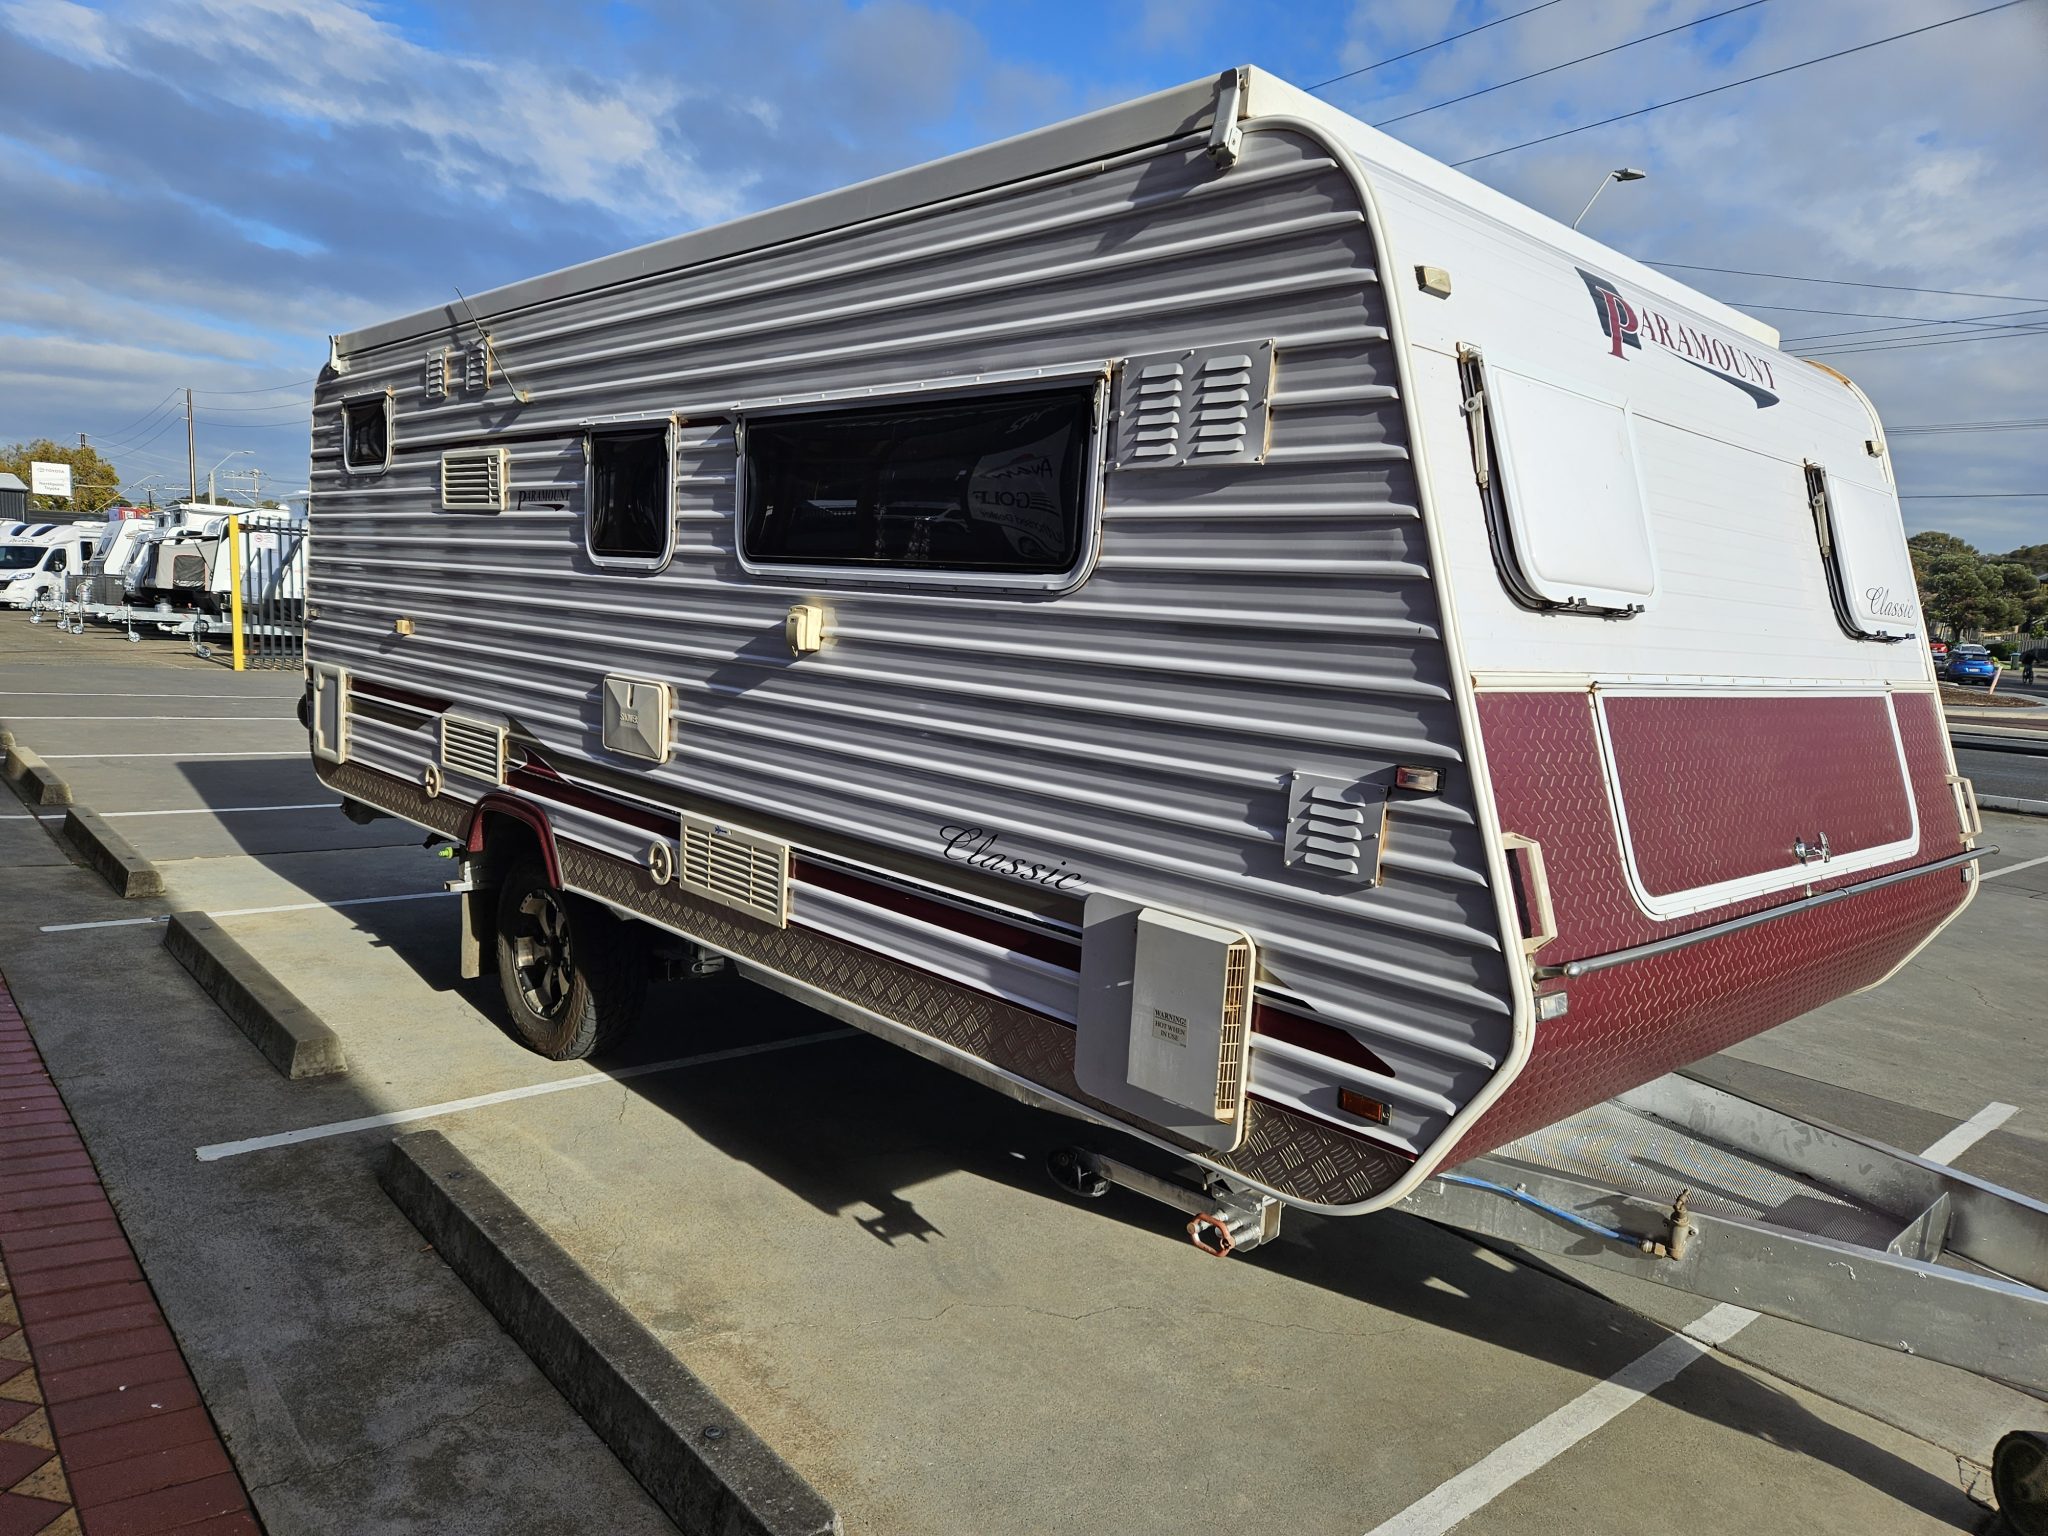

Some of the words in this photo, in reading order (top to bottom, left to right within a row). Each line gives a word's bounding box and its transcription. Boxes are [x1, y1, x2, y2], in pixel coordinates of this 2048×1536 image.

[1595, 285, 1776, 390] PARAMOUNT
[517, 488, 571, 511] PARAMOUNT
[1866, 586, 1915, 618] Classic
[939, 825, 1089, 890] Classic
[1154, 1009, 1187, 1025] WARNING!
[1155, 1020, 1167, 1029] HOT
[1167, 1024, 1185, 1036] WHEN
[1167, 1032, 1179, 1041] USE
